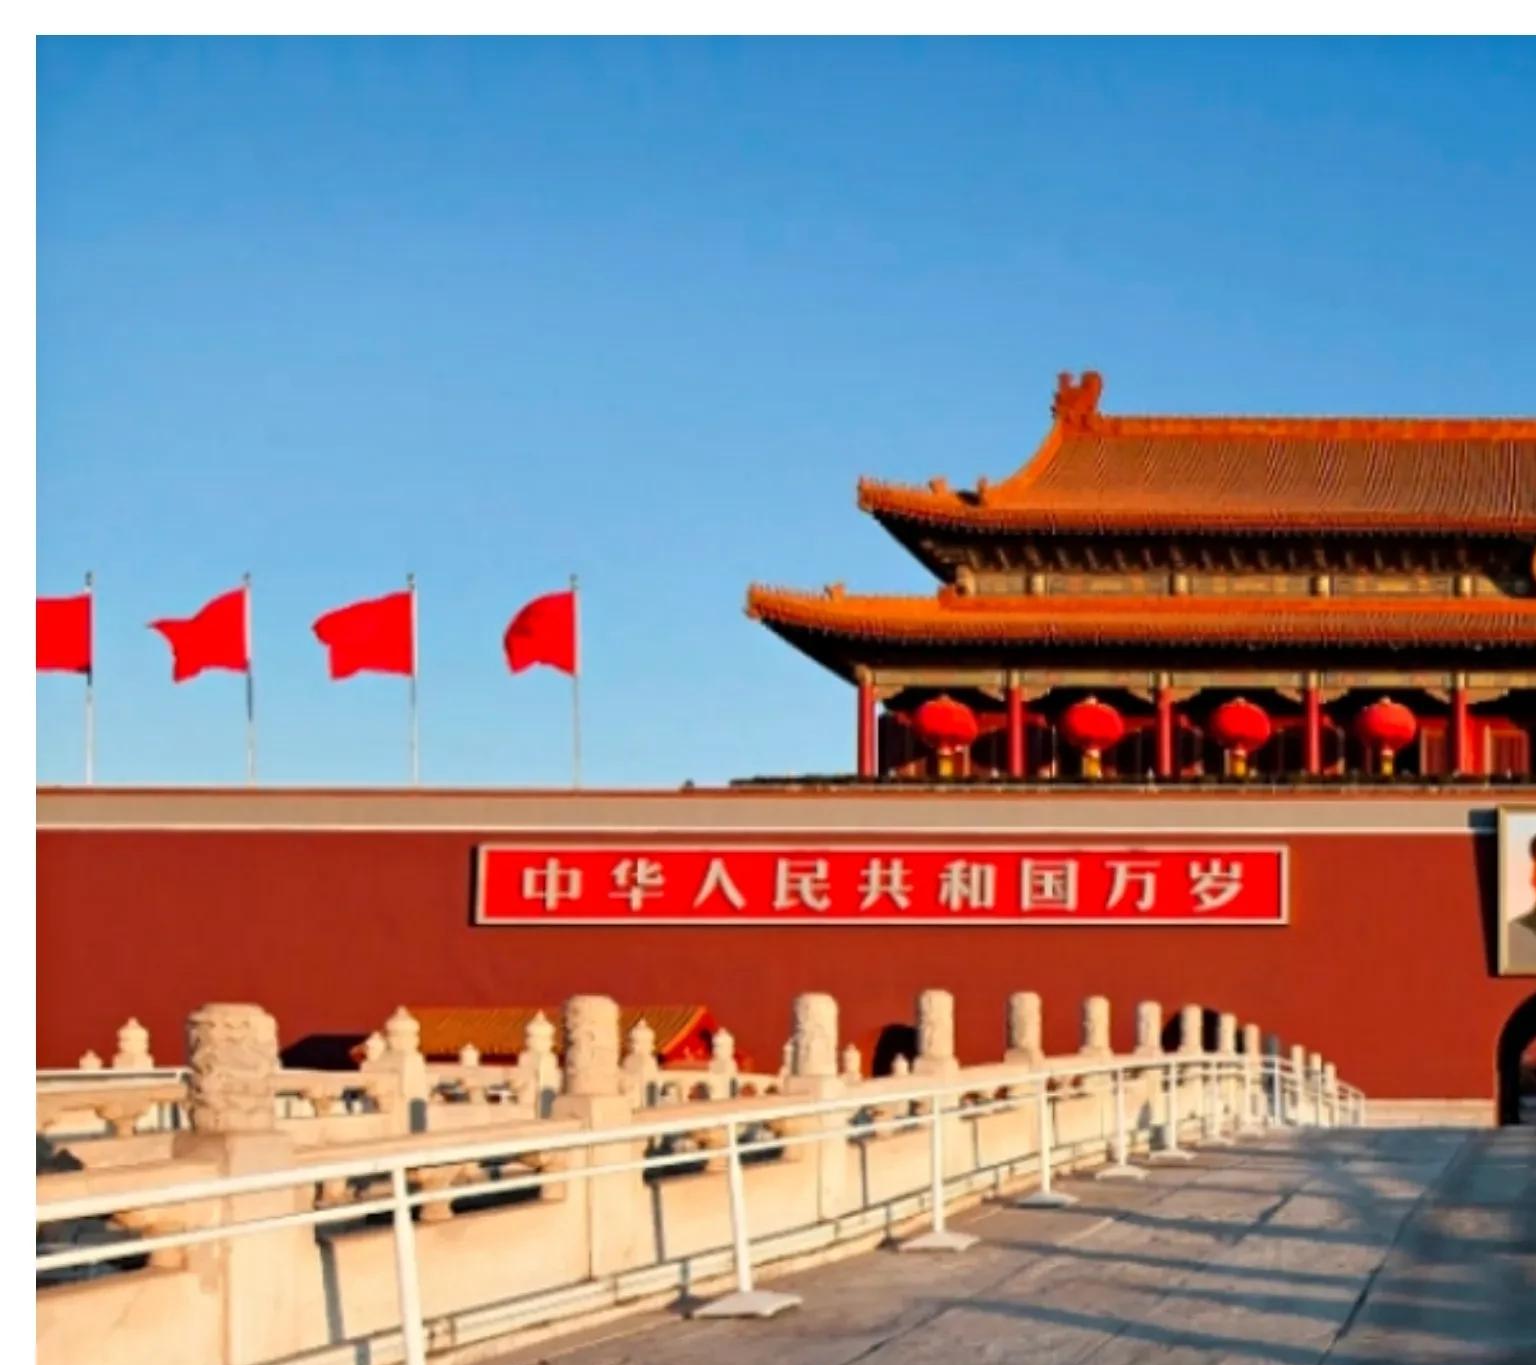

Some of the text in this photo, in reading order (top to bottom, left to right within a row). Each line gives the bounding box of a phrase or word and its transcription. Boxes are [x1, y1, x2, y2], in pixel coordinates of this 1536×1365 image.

[521, 857, 1244, 912] 中华人民共和国万岁
